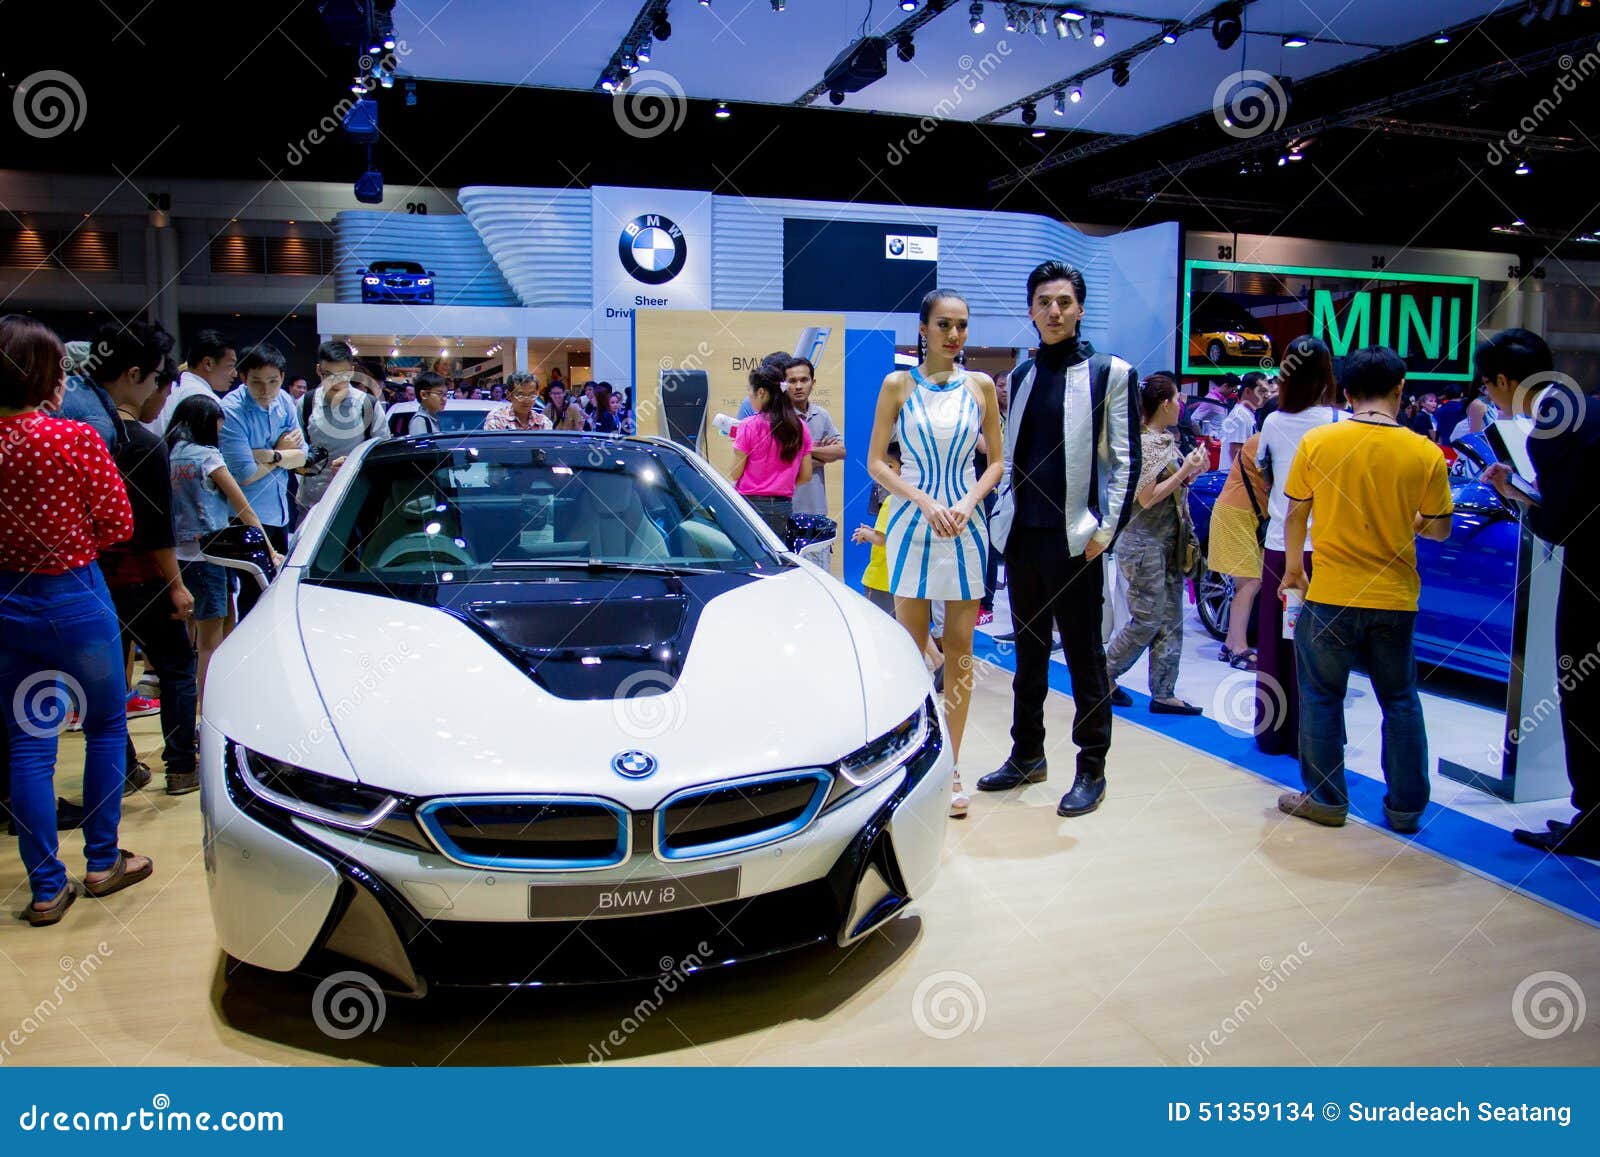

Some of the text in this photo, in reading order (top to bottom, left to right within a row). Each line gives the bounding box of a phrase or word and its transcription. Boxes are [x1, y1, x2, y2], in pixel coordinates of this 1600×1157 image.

[625, 215, 682, 238] BMW
[1218, 246, 1232, 260] 33
[635, 295, 669, 306] Sheer
[606, 307, 632, 319] Drivi
[1312, 289, 1461, 361] MINI
[599, 886, 676, 909] BMW i8
